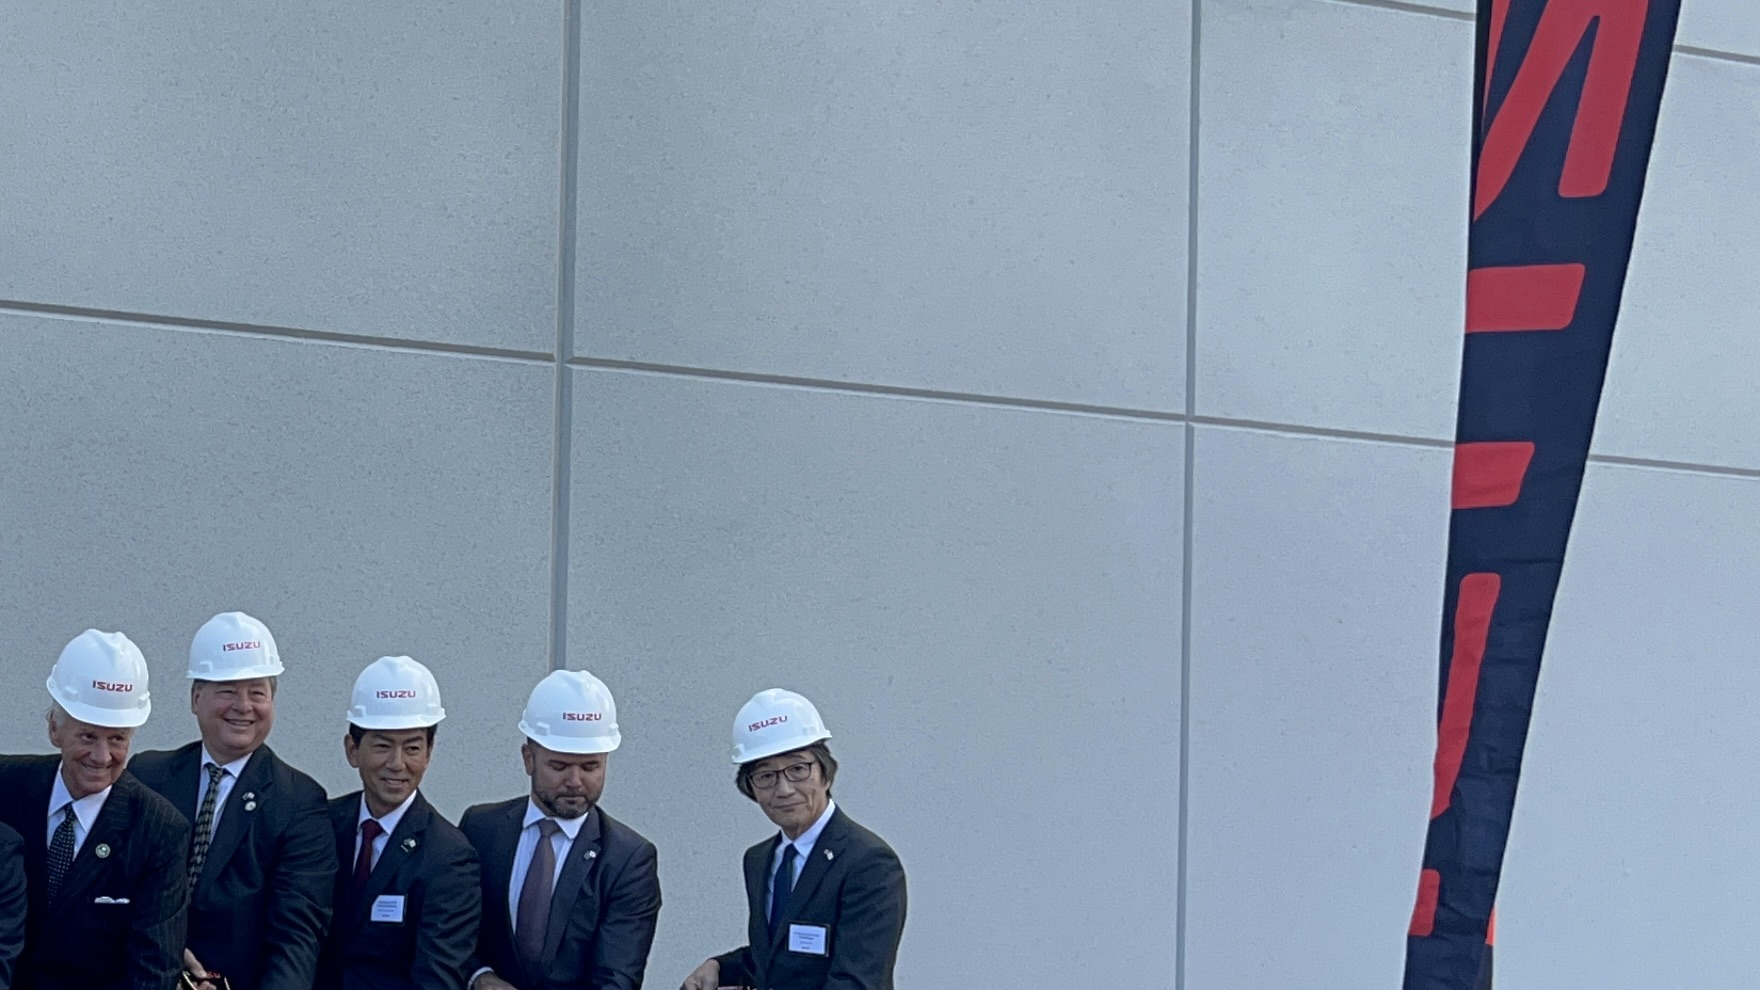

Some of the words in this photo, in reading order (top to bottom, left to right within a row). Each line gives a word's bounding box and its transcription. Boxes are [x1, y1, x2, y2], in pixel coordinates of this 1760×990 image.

[222, 641, 260, 653] ISUZU
[92, 680, 133, 694] ISUZU
[376, 689, 416, 699] ISUZU
[562, 711, 602, 721] ISUZU
[748, 714, 788, 733] ISUZU
